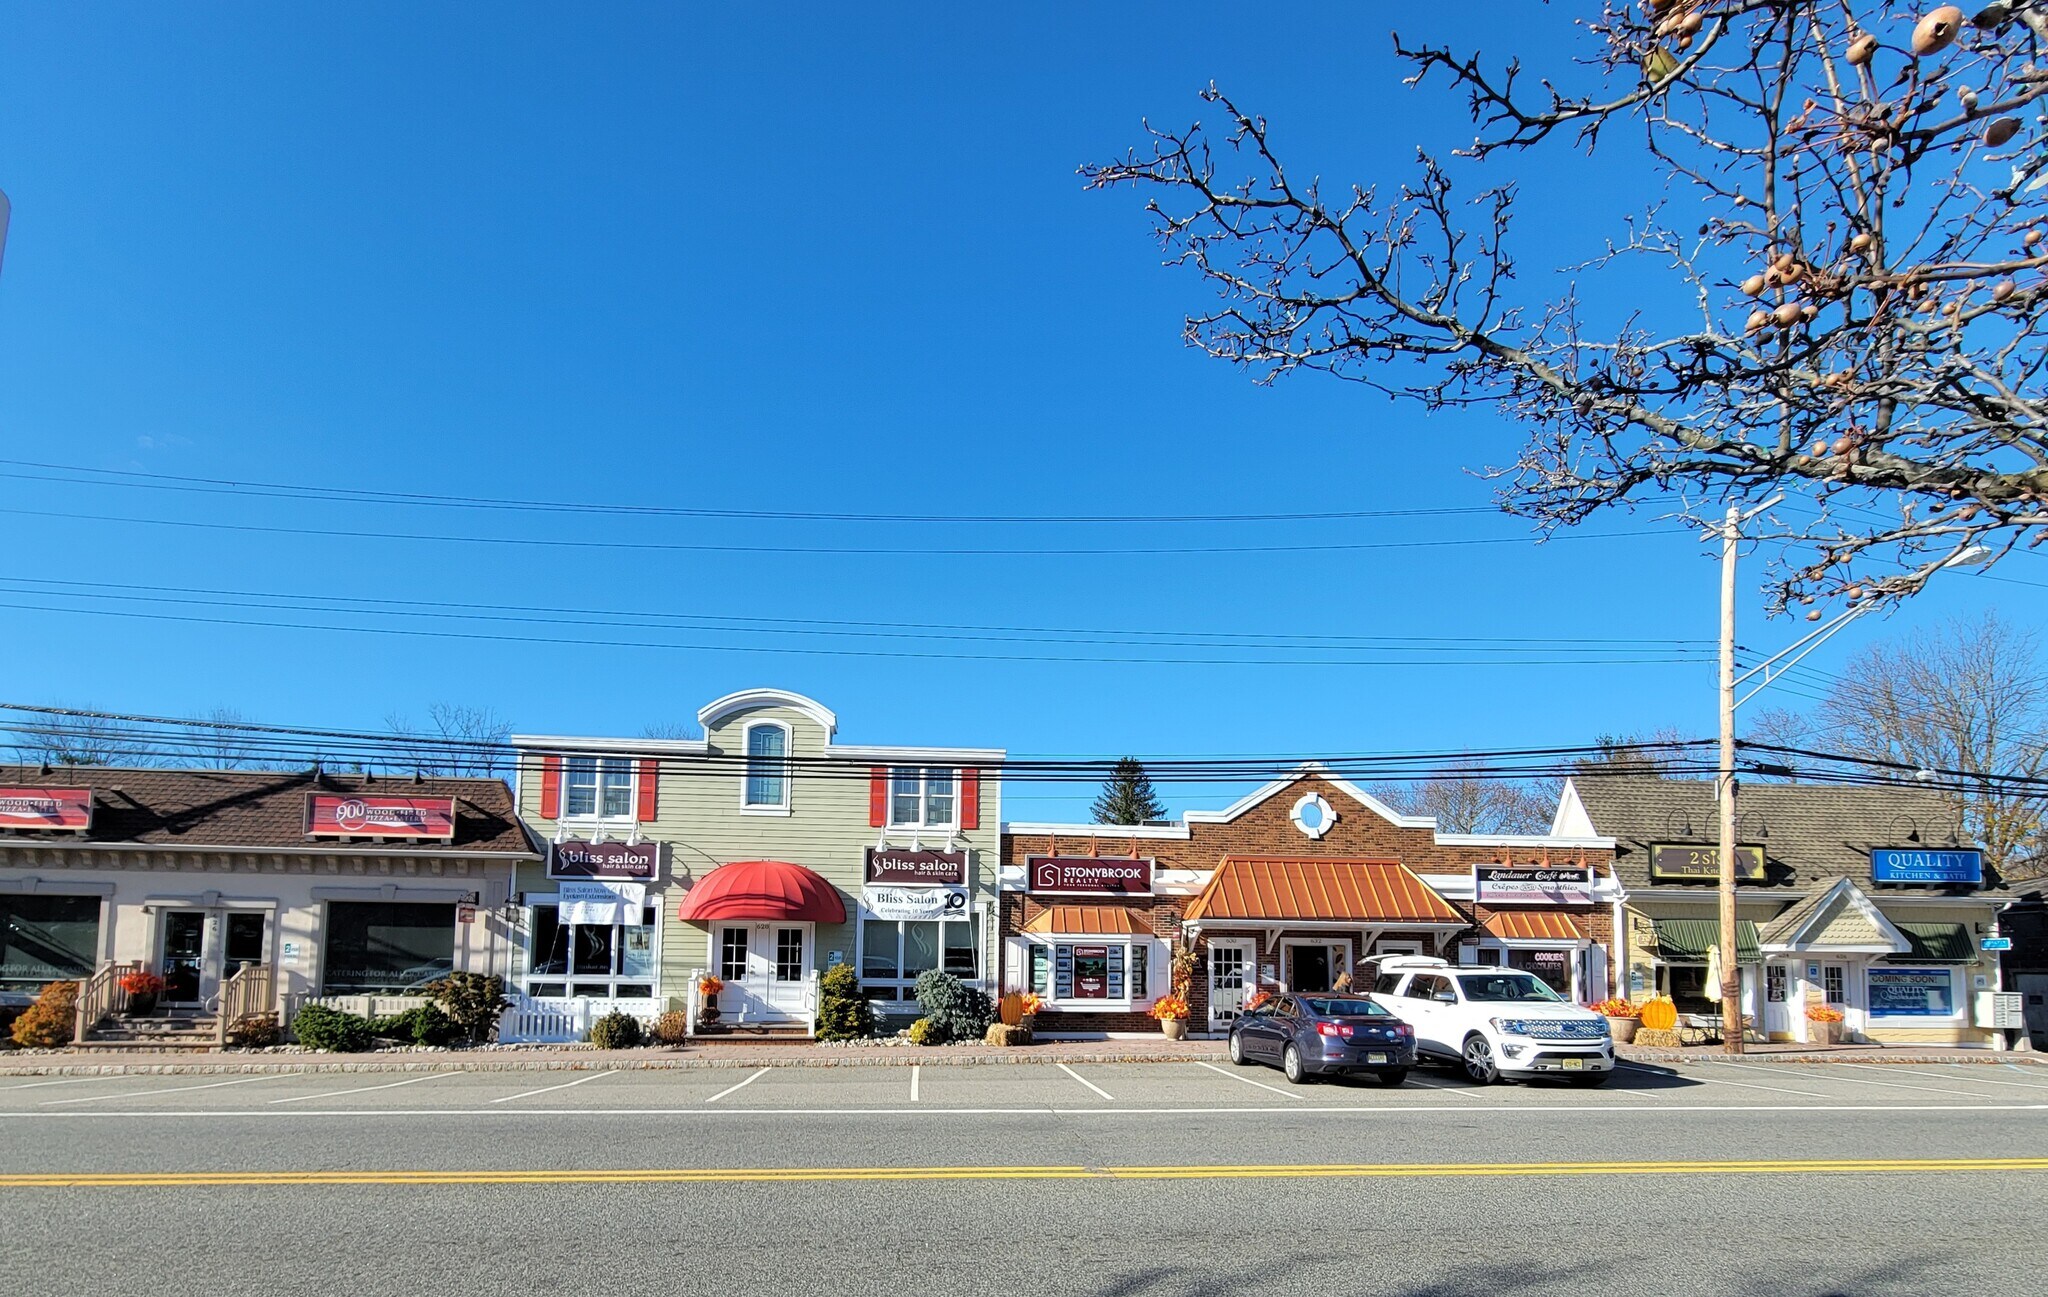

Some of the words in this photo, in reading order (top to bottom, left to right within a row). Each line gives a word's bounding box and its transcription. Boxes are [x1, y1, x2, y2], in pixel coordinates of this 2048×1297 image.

[569, 850, 603, 864] bliss
[608, 852, 649, 865] salon
[1690, 851, 1700, 865] 2
[1888, 853, 1965, 869] QUALITY
[602, 862, 614, 870] hair
[883, 858, 915, 870] bliss
[919, 859, 958, 871] salon
[1681, 865, 1701, 874] Thai
[1064, 867, 1142, 879] STONYBROOK
[1487, 870, 1533, 881] Landauer
[1535, 870, 1558, 881] Café
[1890, 871, 1931, 880] KITCHEN
[1933, 872, 1942, 880] &
[1943, 872, 1967, 881] BATH
[1491, 883, 1519, 891] Crêpes
[877, 893, 903, 904] Bliss
[906, 894, 938, 905] Salon
[944, 892, 966, 909] 10
[880, 907, 911, 915] Celebrating
[1535, 952, 1564, 962] COOKIES
[1871, 974, 1908, 983] COMING
[1909, 975, 1938, 984] SOON!
